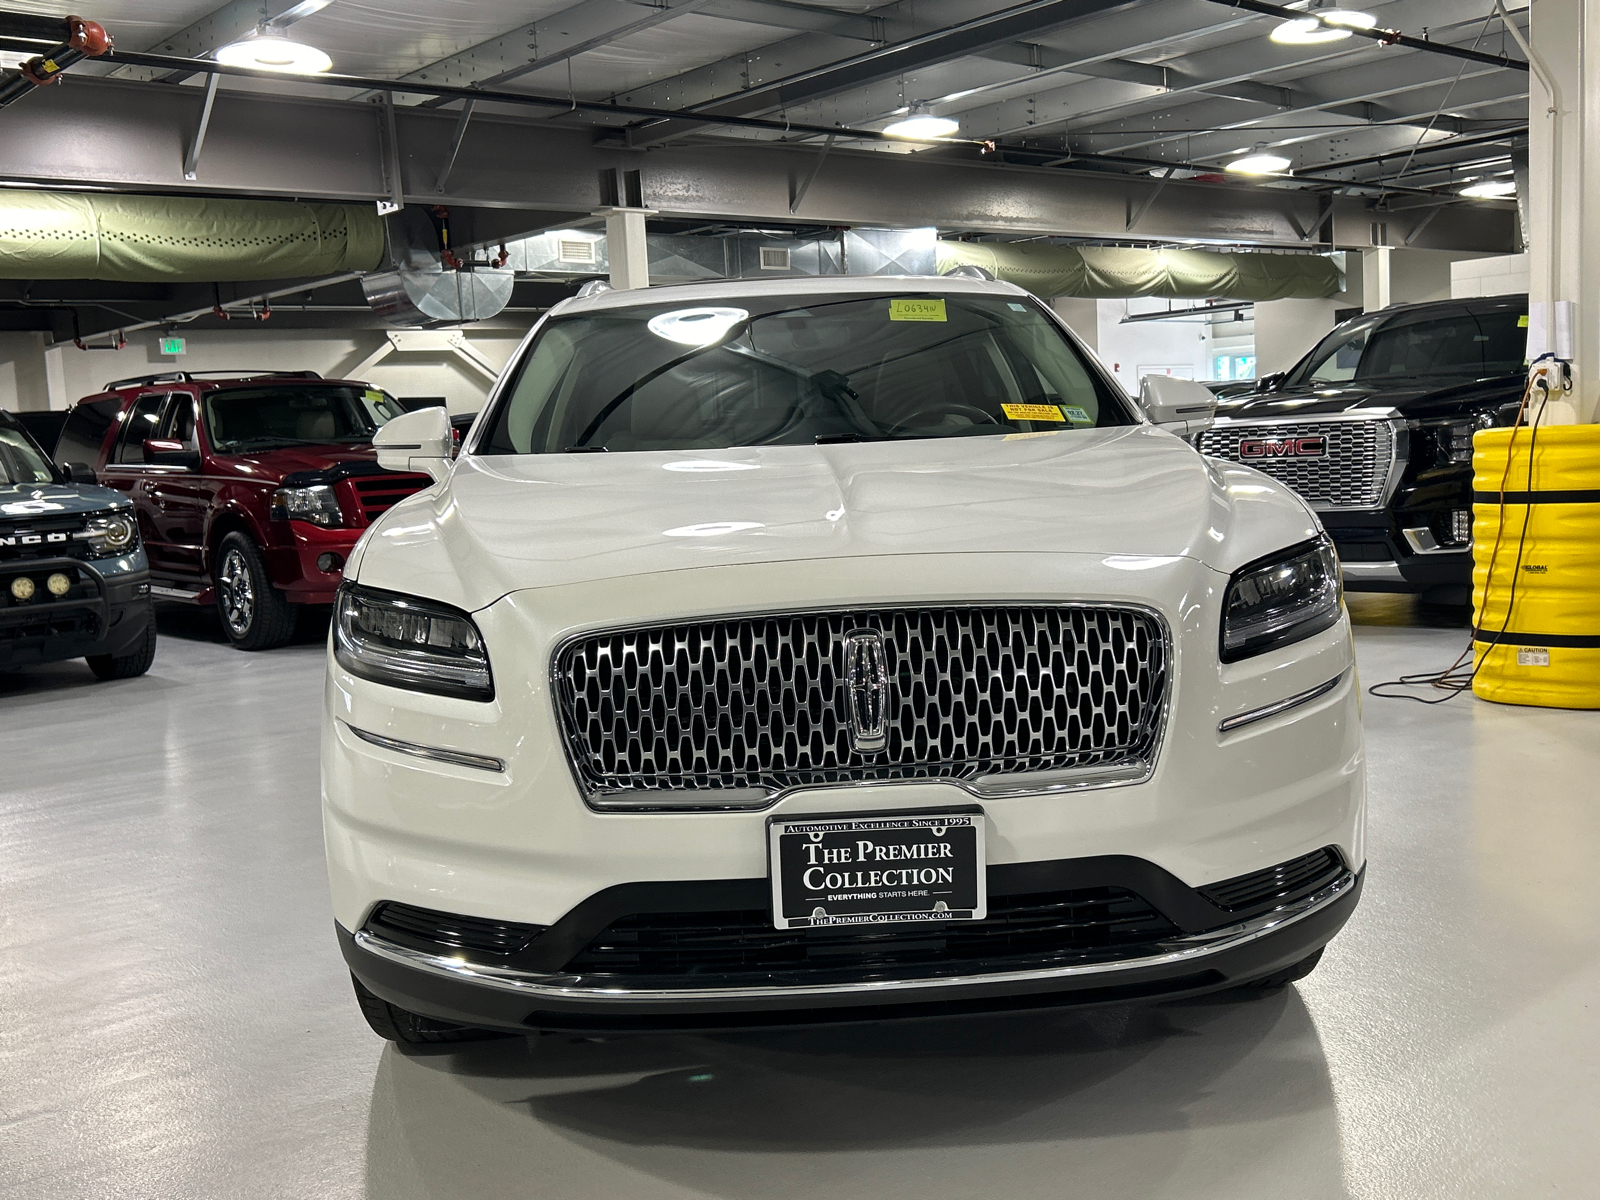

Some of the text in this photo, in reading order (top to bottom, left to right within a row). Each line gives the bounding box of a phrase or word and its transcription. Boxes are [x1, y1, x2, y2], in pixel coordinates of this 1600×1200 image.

[164, 339, 182, 353] EXIT
[1241, 438, 1323, 457] GMC
[786, 817, 970, 833] AUTOMOTIVE EXCELLENCE SINCE 1995
[802, 840, 954, 865] THE PREMIER
[802, 867, 954, 890] COLLECTION
[827, 892, 877, 901] EVERYTHING
[907, 889, 931, 897] HERE.
